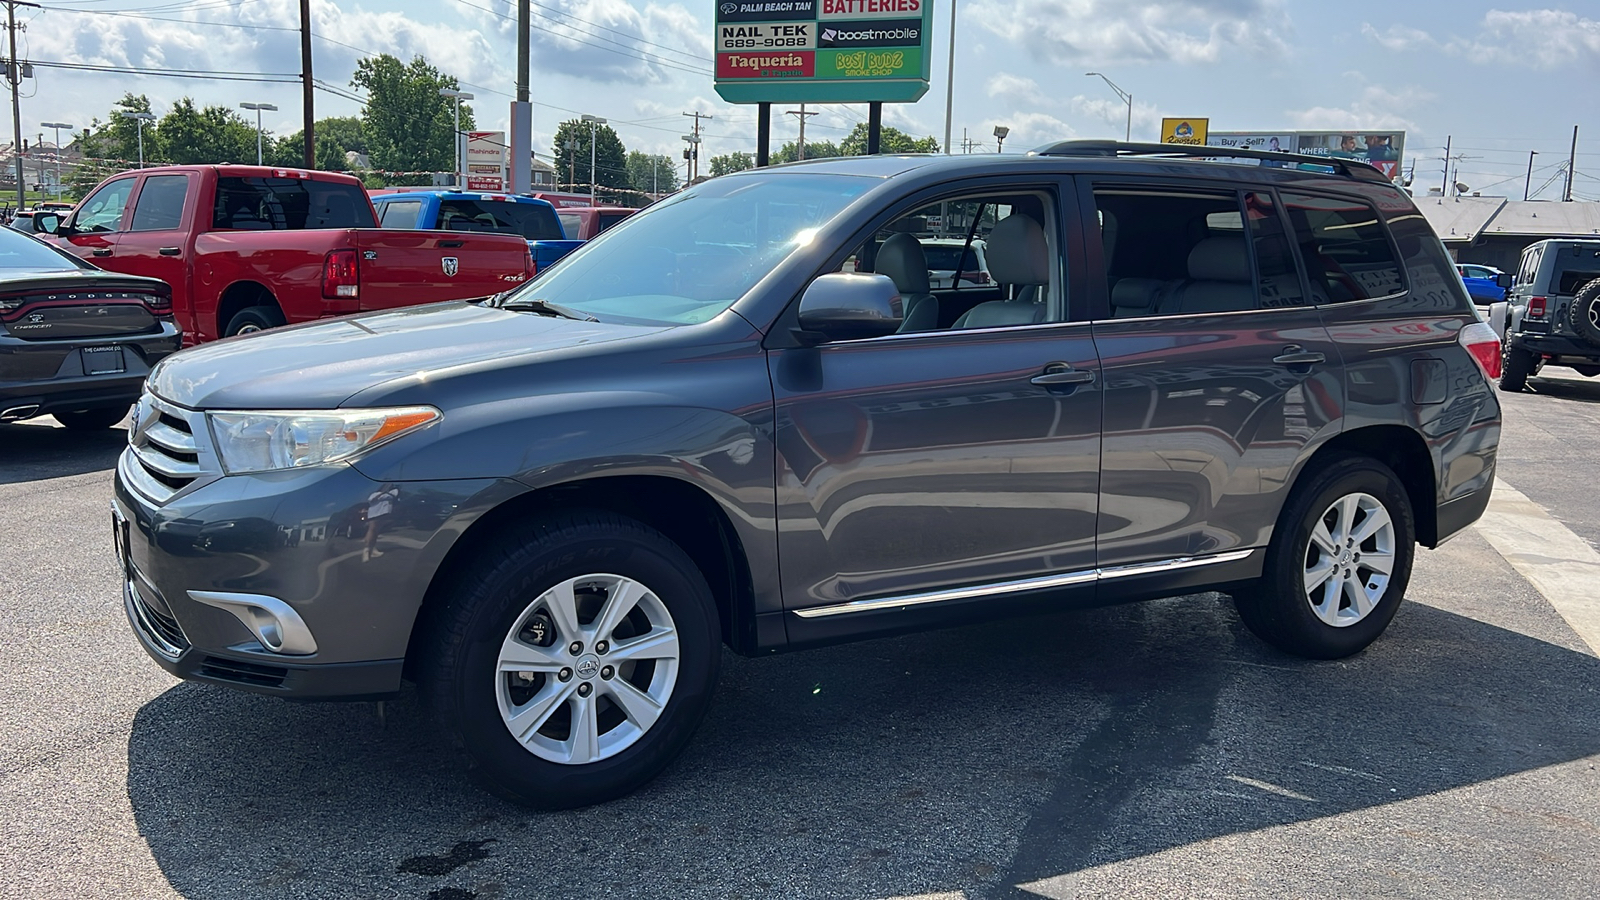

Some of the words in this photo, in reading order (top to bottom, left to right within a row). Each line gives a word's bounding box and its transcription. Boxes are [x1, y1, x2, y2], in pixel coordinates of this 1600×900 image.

[740, 3, 763, 12] PALM
[764, 2, 793, 12] BEACH
[794, 1, 812, 11] TAN
[823, 0, 920, 14] BATTERIES
[722, 26, 763, 38] NAIL
[770, 25, 808, 36] TEK
[838, 27, 918, 40] boostmobile
[724, 37, 807, 48] 689-9088
[845, 69, 870, 77] SMOKE
[1166, 135, 1201, 145] Roosters
[1221, 138, 1237, 147] Buy
[1245, 137, 1265, 146] Sell?
[1299, 147, 1329, 155] WHERE
